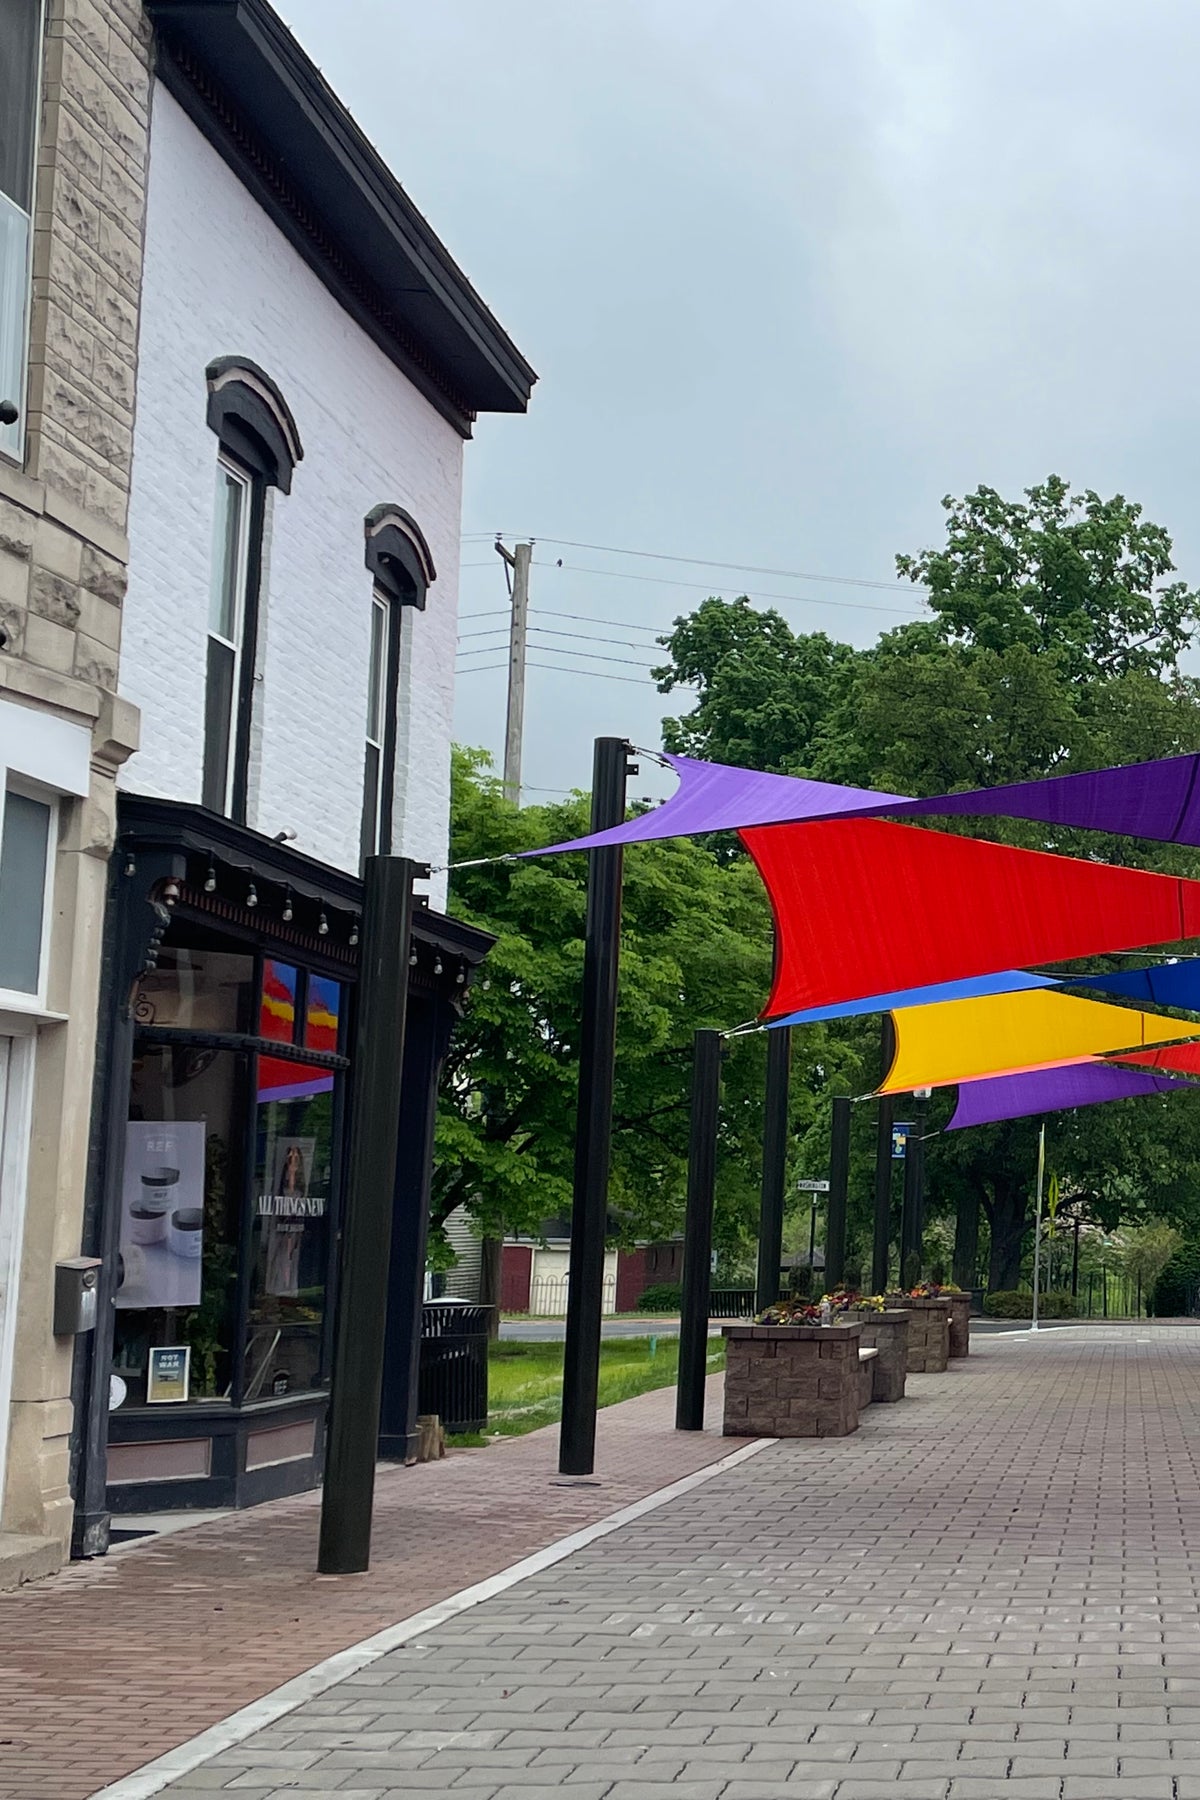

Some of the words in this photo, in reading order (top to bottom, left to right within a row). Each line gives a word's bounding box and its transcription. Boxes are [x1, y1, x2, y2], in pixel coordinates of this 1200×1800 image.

[256, 1195, 273, 1215] ALL
[274, 1196, 305, 1216] THINGS
[306, 1197, 326, 1216] NEW
